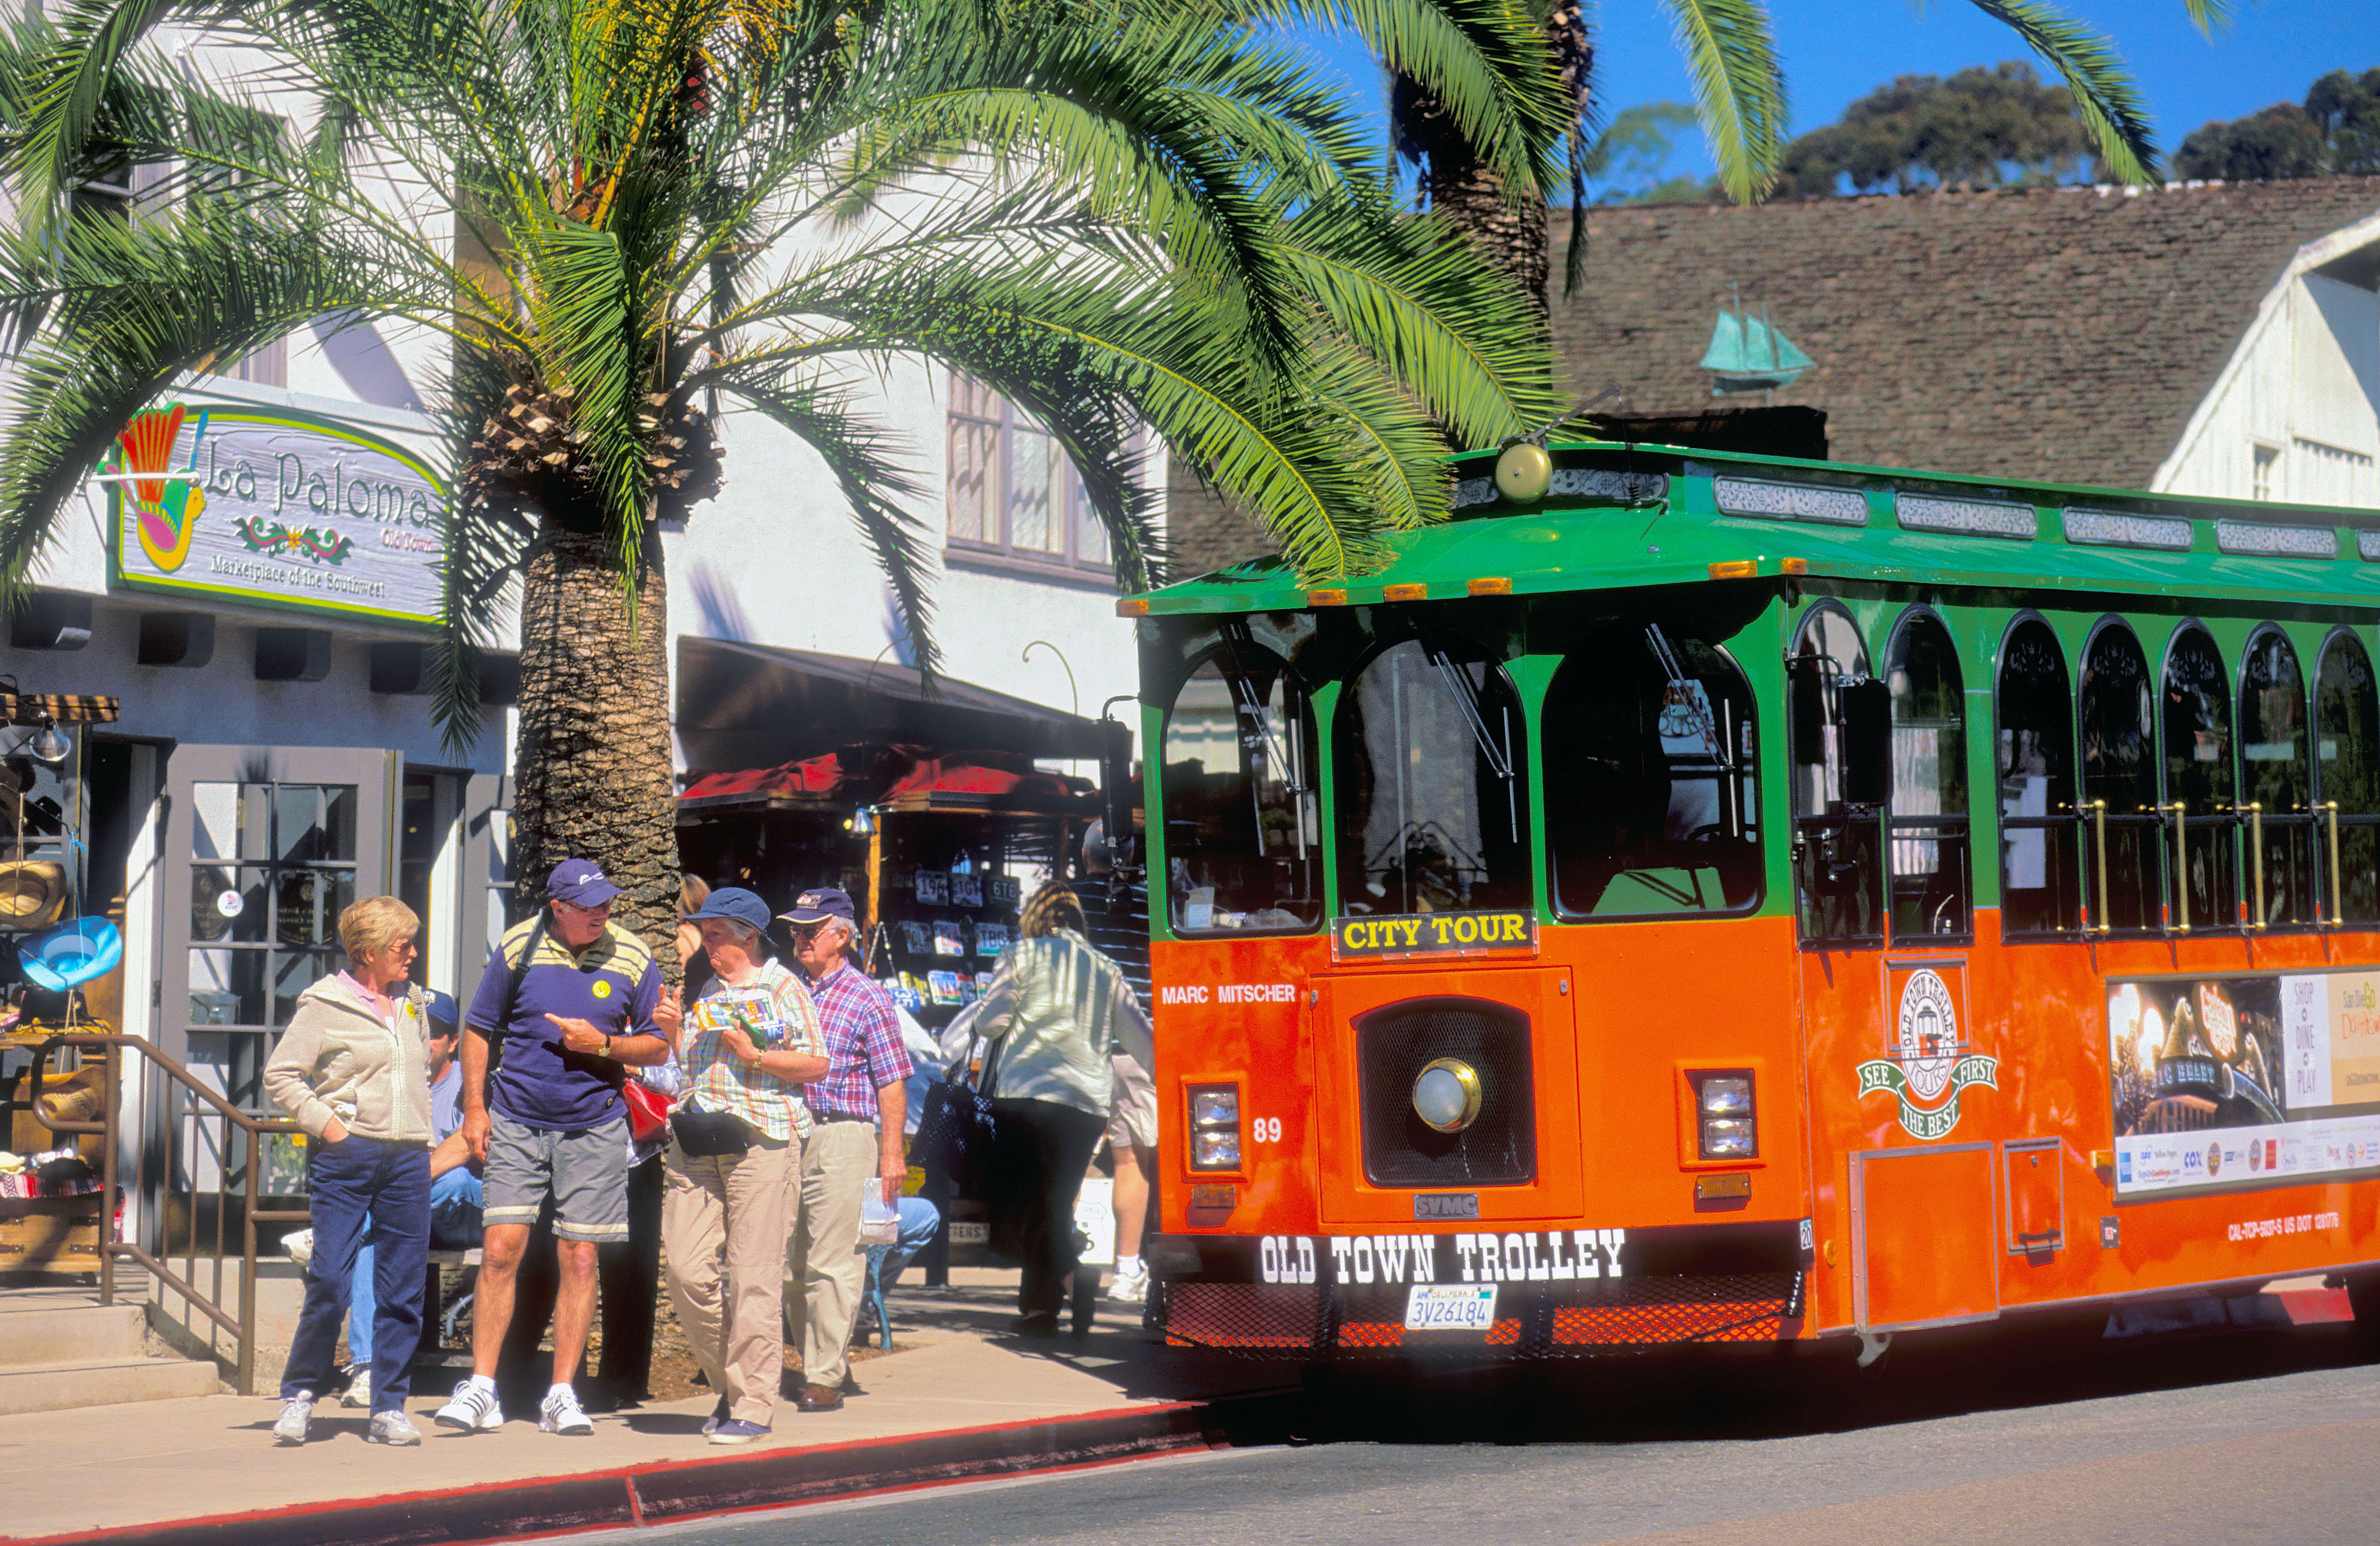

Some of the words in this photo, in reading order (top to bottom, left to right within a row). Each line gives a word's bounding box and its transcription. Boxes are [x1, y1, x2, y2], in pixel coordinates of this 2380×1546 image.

[203, 441, 256, 501] La
[274, 452, 431, 527] Paloma
[381, 528, 402, 548] Old
[403, 531, 433, 553] Town
[211, 556, 285, 583] Marketplace
[289, 568, 302, 586] of
[303, 568, 322, 588] the
[326, 572, 385, 599] Southwest
[1343, 919, 1422, 949] CITY
[1431, 913, 1526, 944] TOUR
[1162, 986, 1208, 1004] MARC
[1218, 984, 1295, 1003] MITSCHER
[1905, 977, 1926, 1010] TOWN
[2295, 982, 2313, 1005] SHOP
[1929, 977, 1955, 1046] TROLLEY
[1903, 1015, 1912, 1046] OLD
[2296, 1025, 2314, 1050] DINE
[1864, 1065, 1890, 1087] SEE
[1960, 1060, 1993, 1084] FIRST
[2297, 1069, 2316, 1093] PLAY
[1902, 1103, 1924, 1135] THE
[1928, 1099, 1957, 1136] BEST
[1253, 1118, 1281, 1142] 89
[2184, 1151, 2203, 1168] COX
[1417, 1196, 1476, 1215] SVMC
[2284, 1217, 2295, 1234] US
[2296, 1215, 2312, 1232] DOT
[1802, 1227, 1811, 1247] 20
[1260, 1235, 1316, 1284] OLD
[1330, 1234, 1435, 1284] TOWN
[1456, 1228, 1626, 1282] TROLLEY
[1431, 1290, 1475, 1299] CALIFORNIA
[1413, 1301, 1485, 1322] 3V26184
